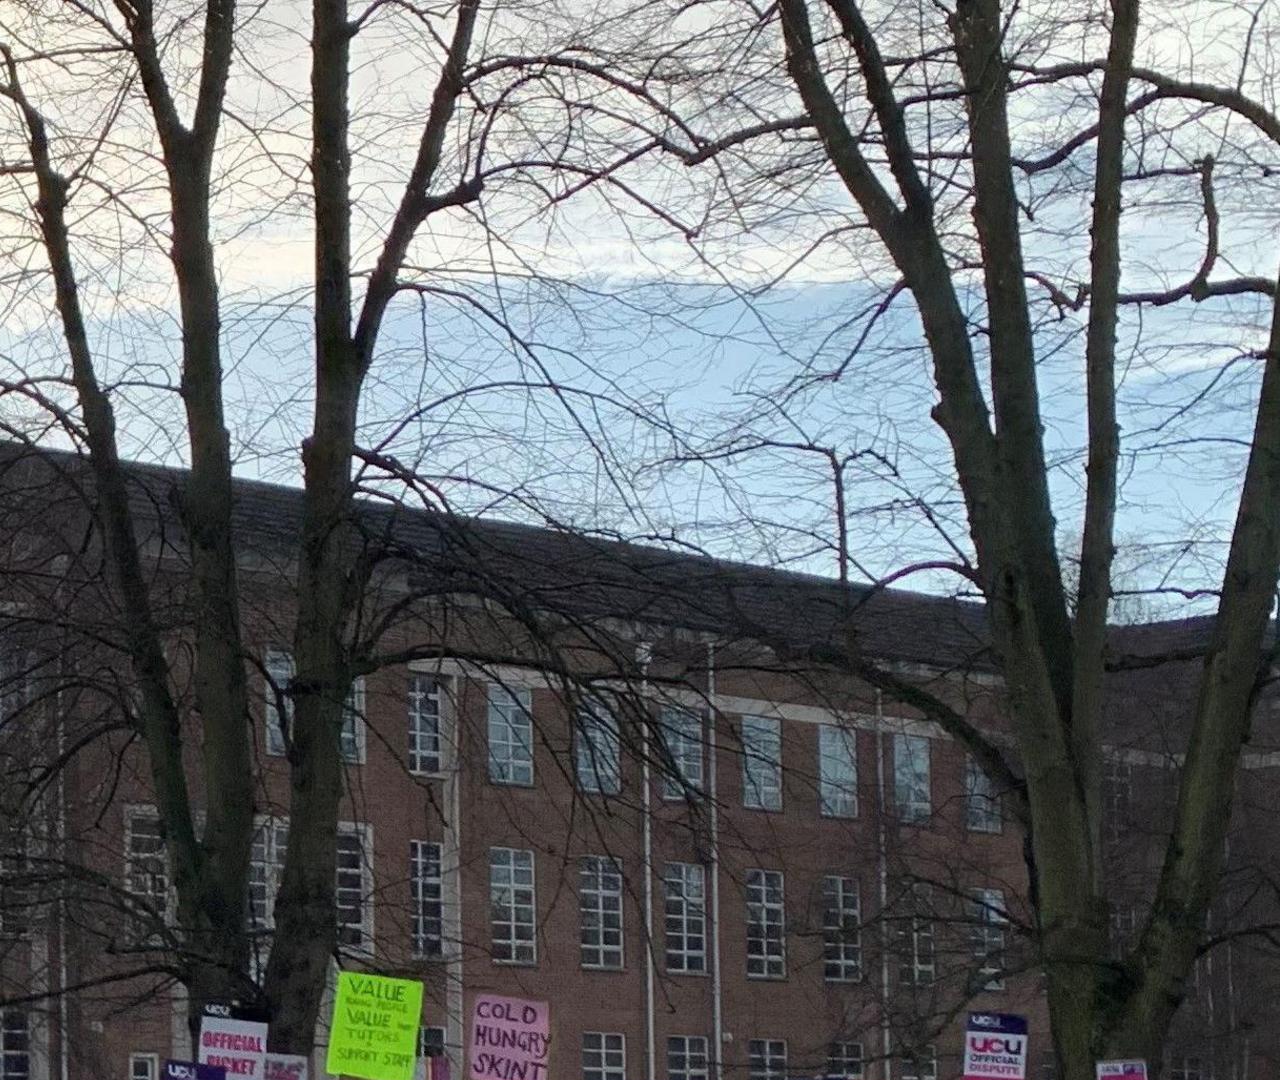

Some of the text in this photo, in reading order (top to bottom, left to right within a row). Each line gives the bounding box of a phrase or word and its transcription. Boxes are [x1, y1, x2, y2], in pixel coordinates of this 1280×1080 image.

[348, 978, 407, 1001] VALUE
[346, 1007, 391, 1027] VALUE
[477, 1001, 537, 1024] COLD
[202, 1031, 262, 1052] OFFICIAL
[475, 1024, 551, 1059] HUNGRY
[969, 1063, 1020, 1075] DISPUTE
[970, 1054, 1020, 1065] OFFICIAL
